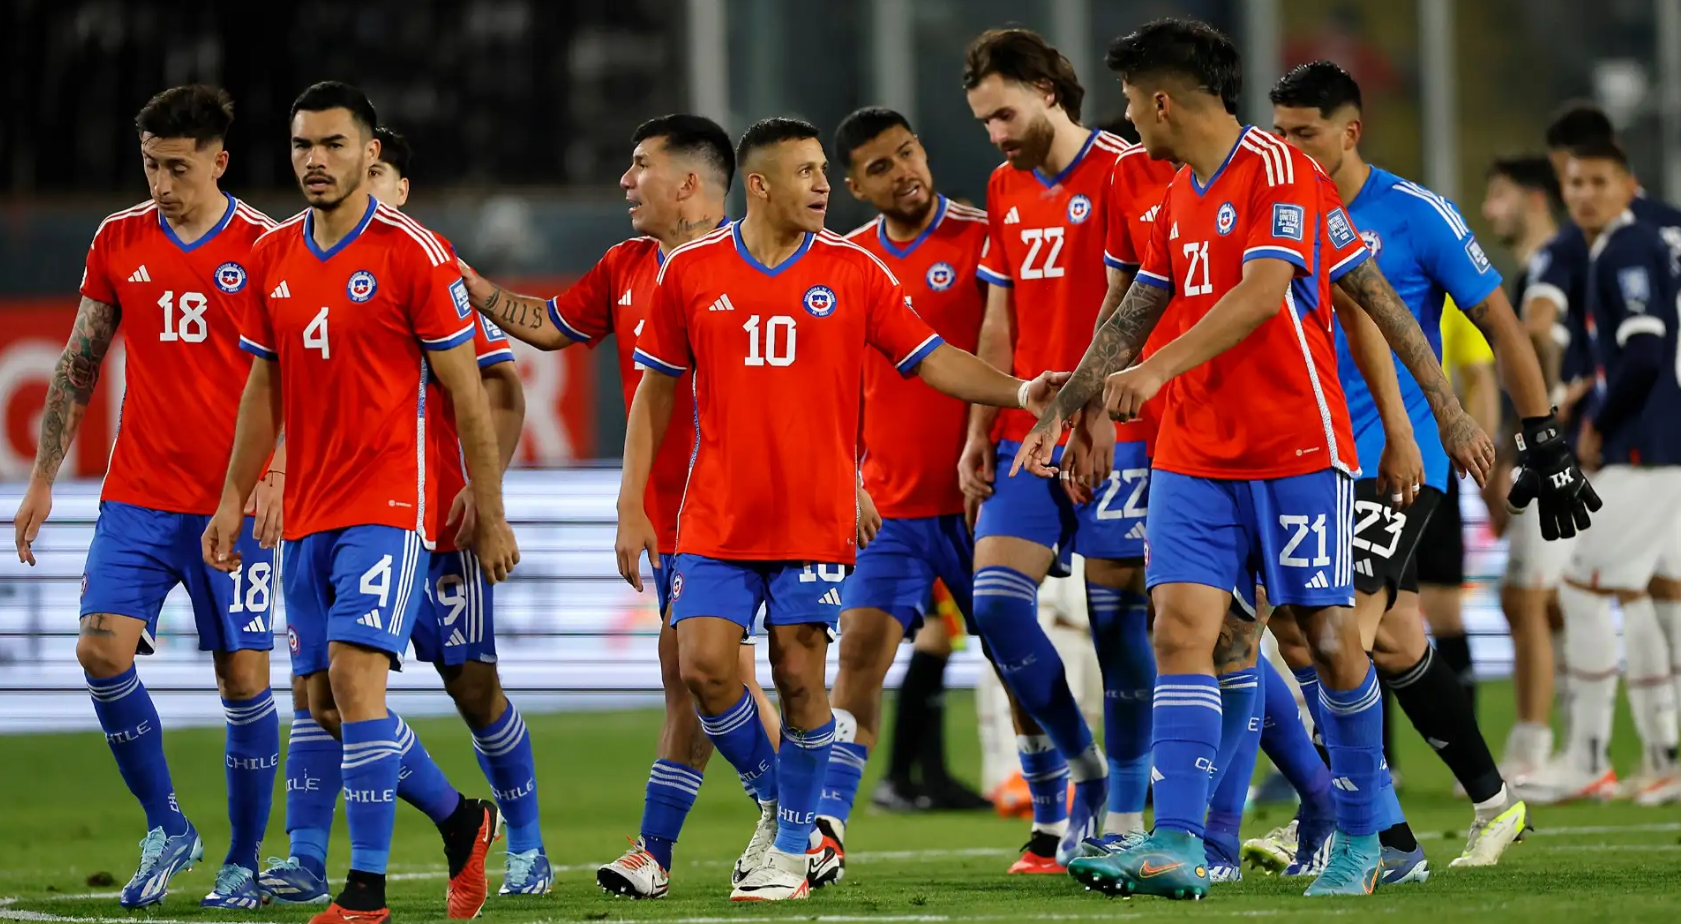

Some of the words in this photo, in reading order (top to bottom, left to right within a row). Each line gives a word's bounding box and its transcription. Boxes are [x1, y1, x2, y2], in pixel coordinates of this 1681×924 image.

[1020, 226, 1065, 280] 22
[1183, 240, 1213, 297] 21
[157, 290, 208, 343] 18
[303, 306, 331, 360] 4
[742, 314, 797, 367] 10
[1096, 468, 1149, 520] 22
[1279, 513, 1331, 568] 21
[1352, 500, 1407, 559] 23
[228, 562, 272, 613] 18
[360, 553, 393, 608] 4
[226, 752, 279, 770] CHILE
[343, 786, 394, 803] CHILE
[777, 804, 815, 825] HILE
